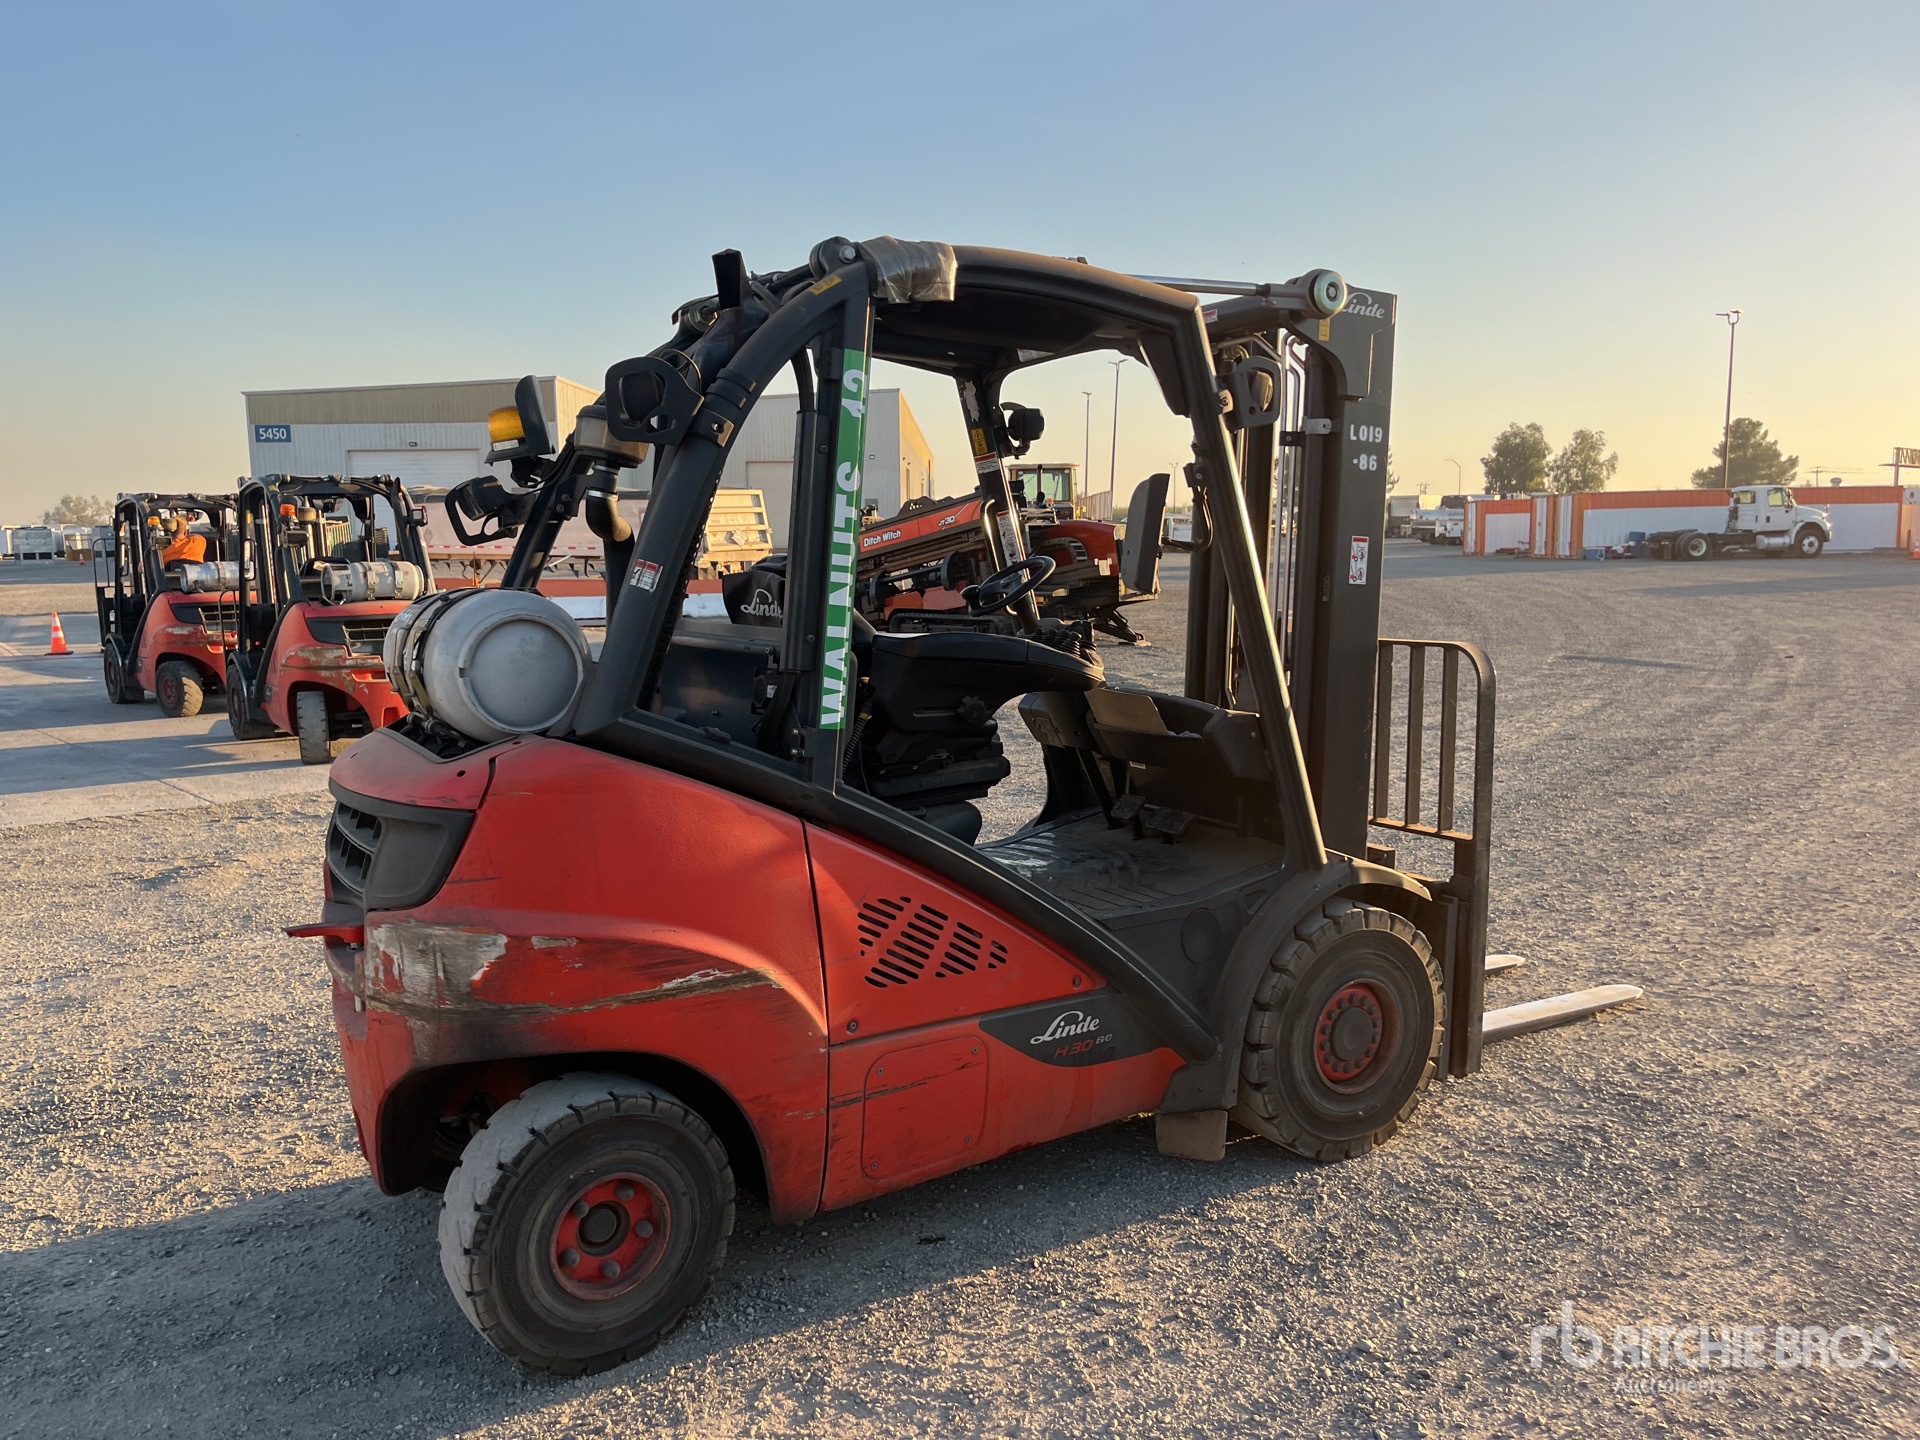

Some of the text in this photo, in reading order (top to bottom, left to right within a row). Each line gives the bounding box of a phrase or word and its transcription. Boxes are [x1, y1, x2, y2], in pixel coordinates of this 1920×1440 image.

[259, 427, 288, 440] 5450
[863, 529, 902, 547] Ditch Witch
[820, 460, 862, 726] WALNUTS
[1029, 1010, 1100, 1045] Linde
[1053, 1039, 1095, 1059] H30
